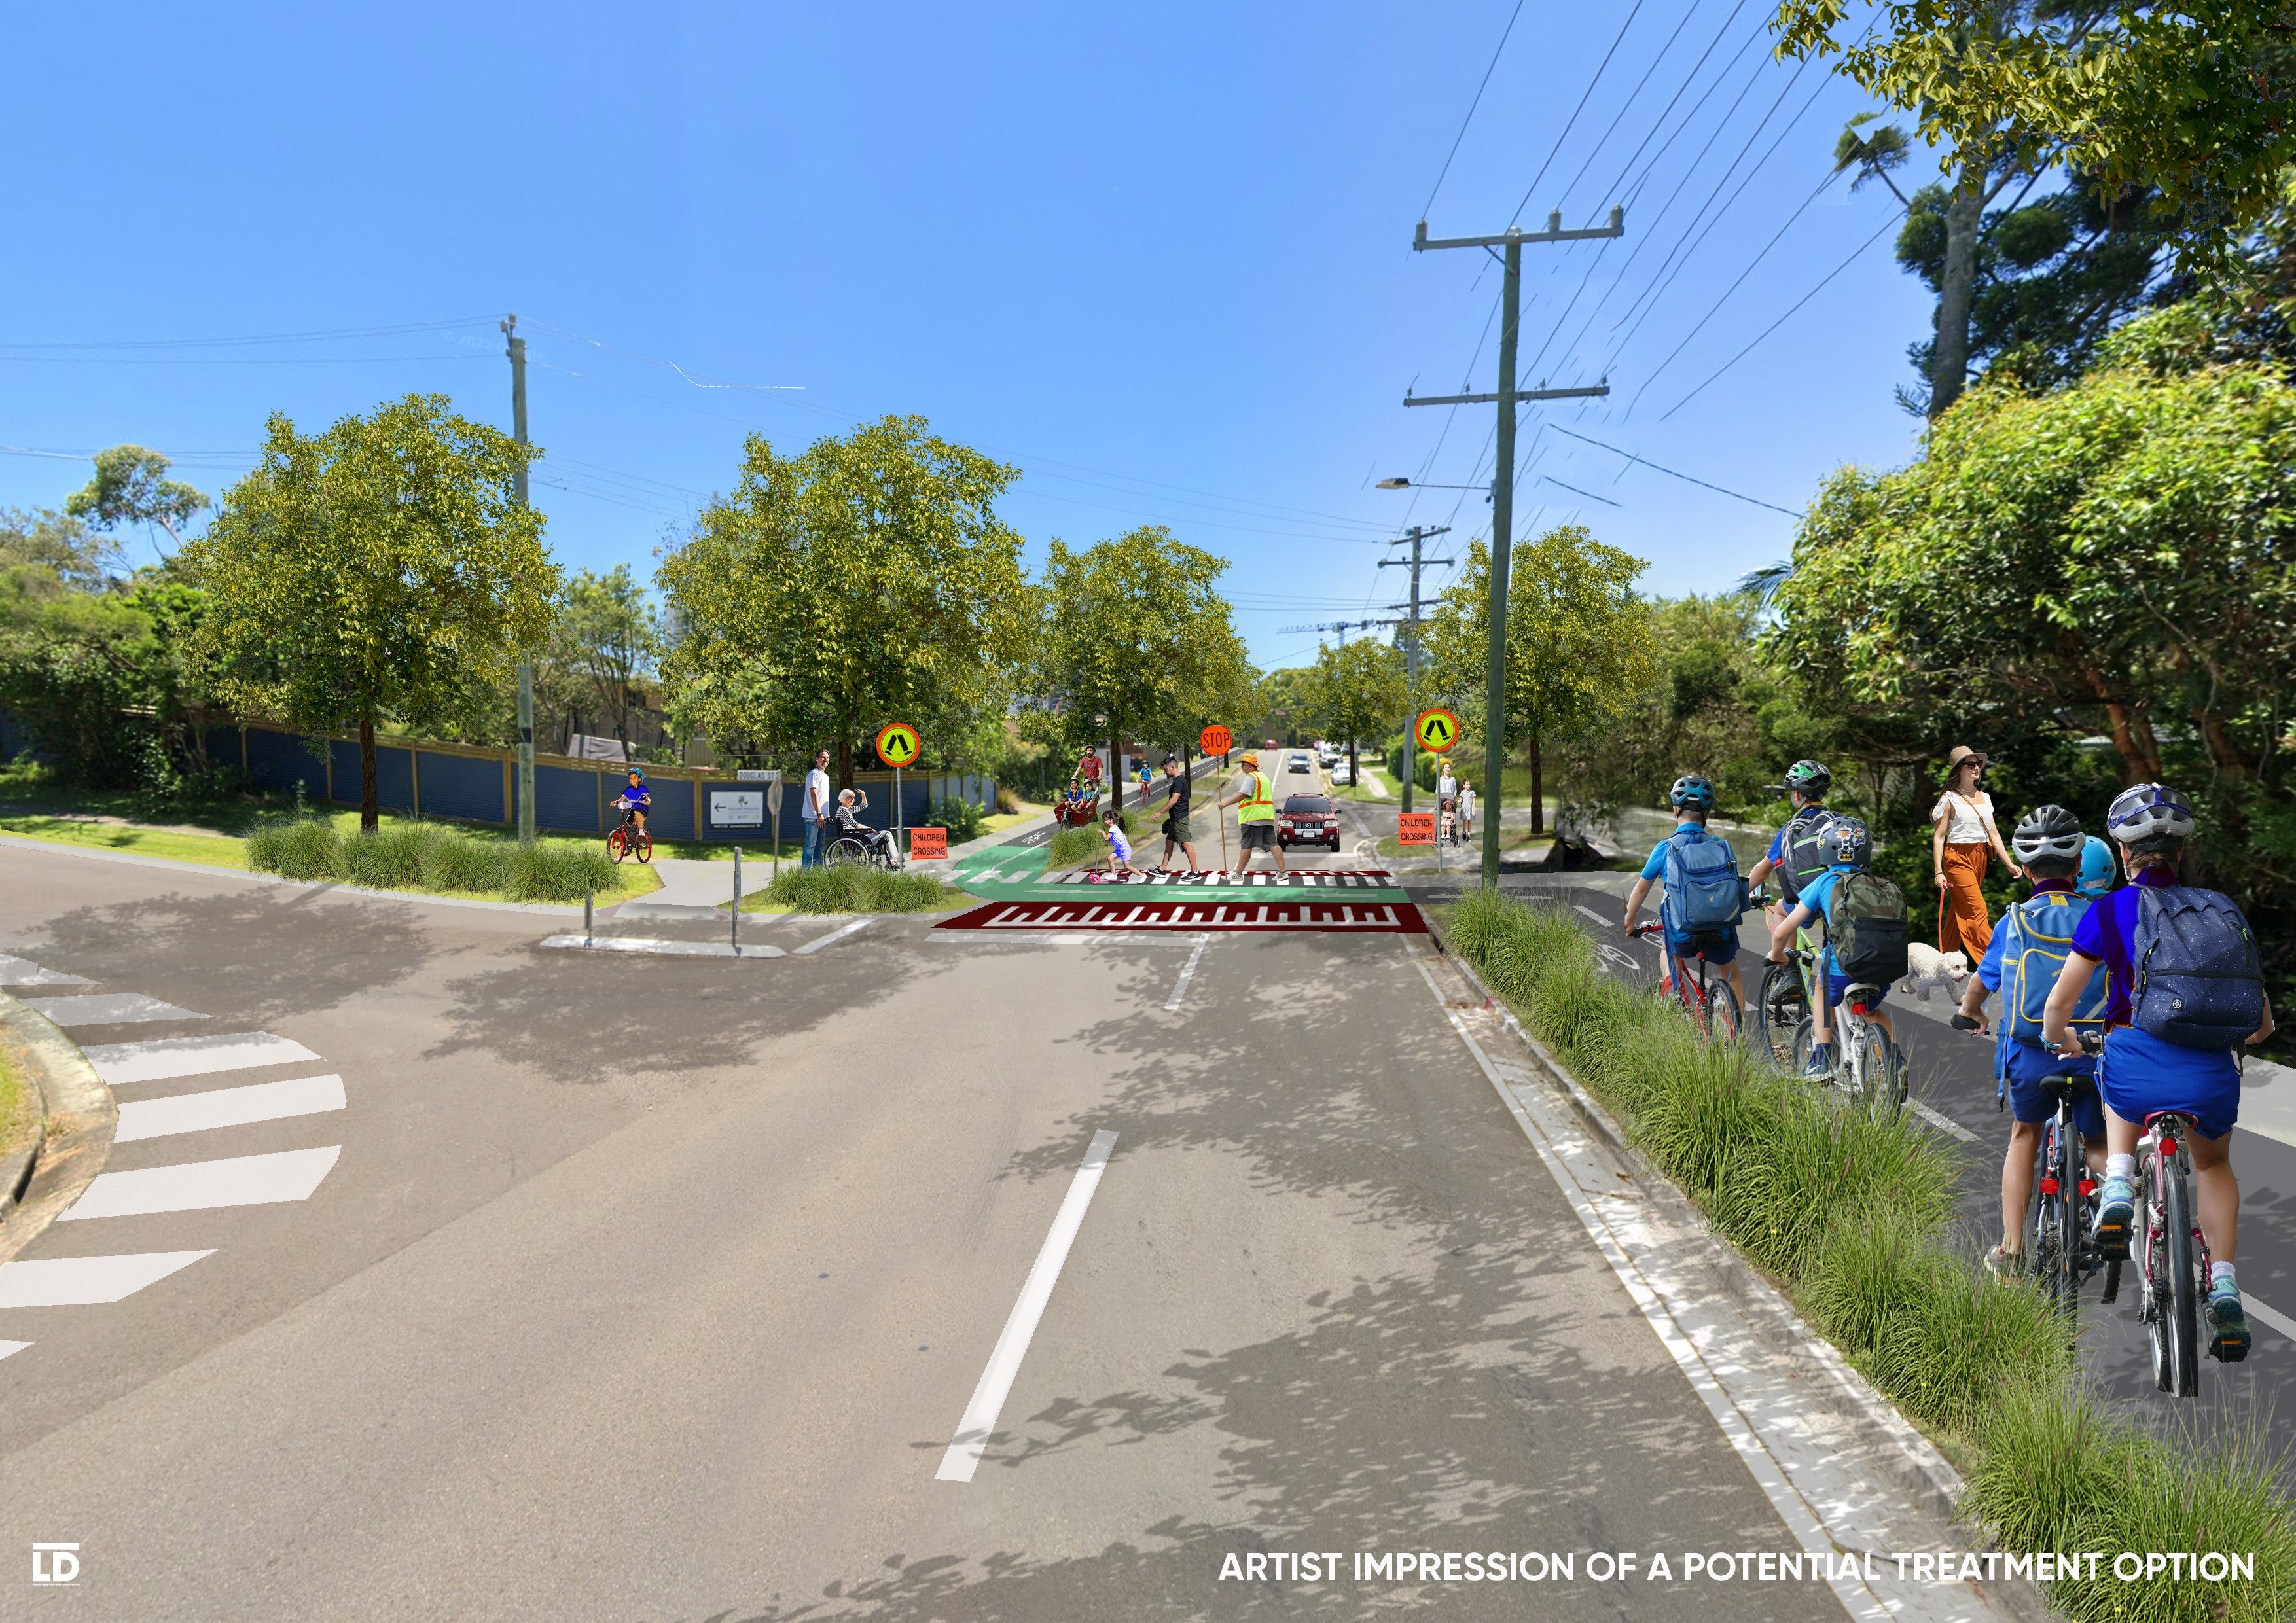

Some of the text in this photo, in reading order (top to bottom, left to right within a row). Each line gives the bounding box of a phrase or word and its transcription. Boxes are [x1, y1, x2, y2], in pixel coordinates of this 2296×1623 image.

[1203, 732, 1230, 749] STOP
[1401, 832, 1433, 841] CROSSING
[913, 847, 946, 855] CROSSING
